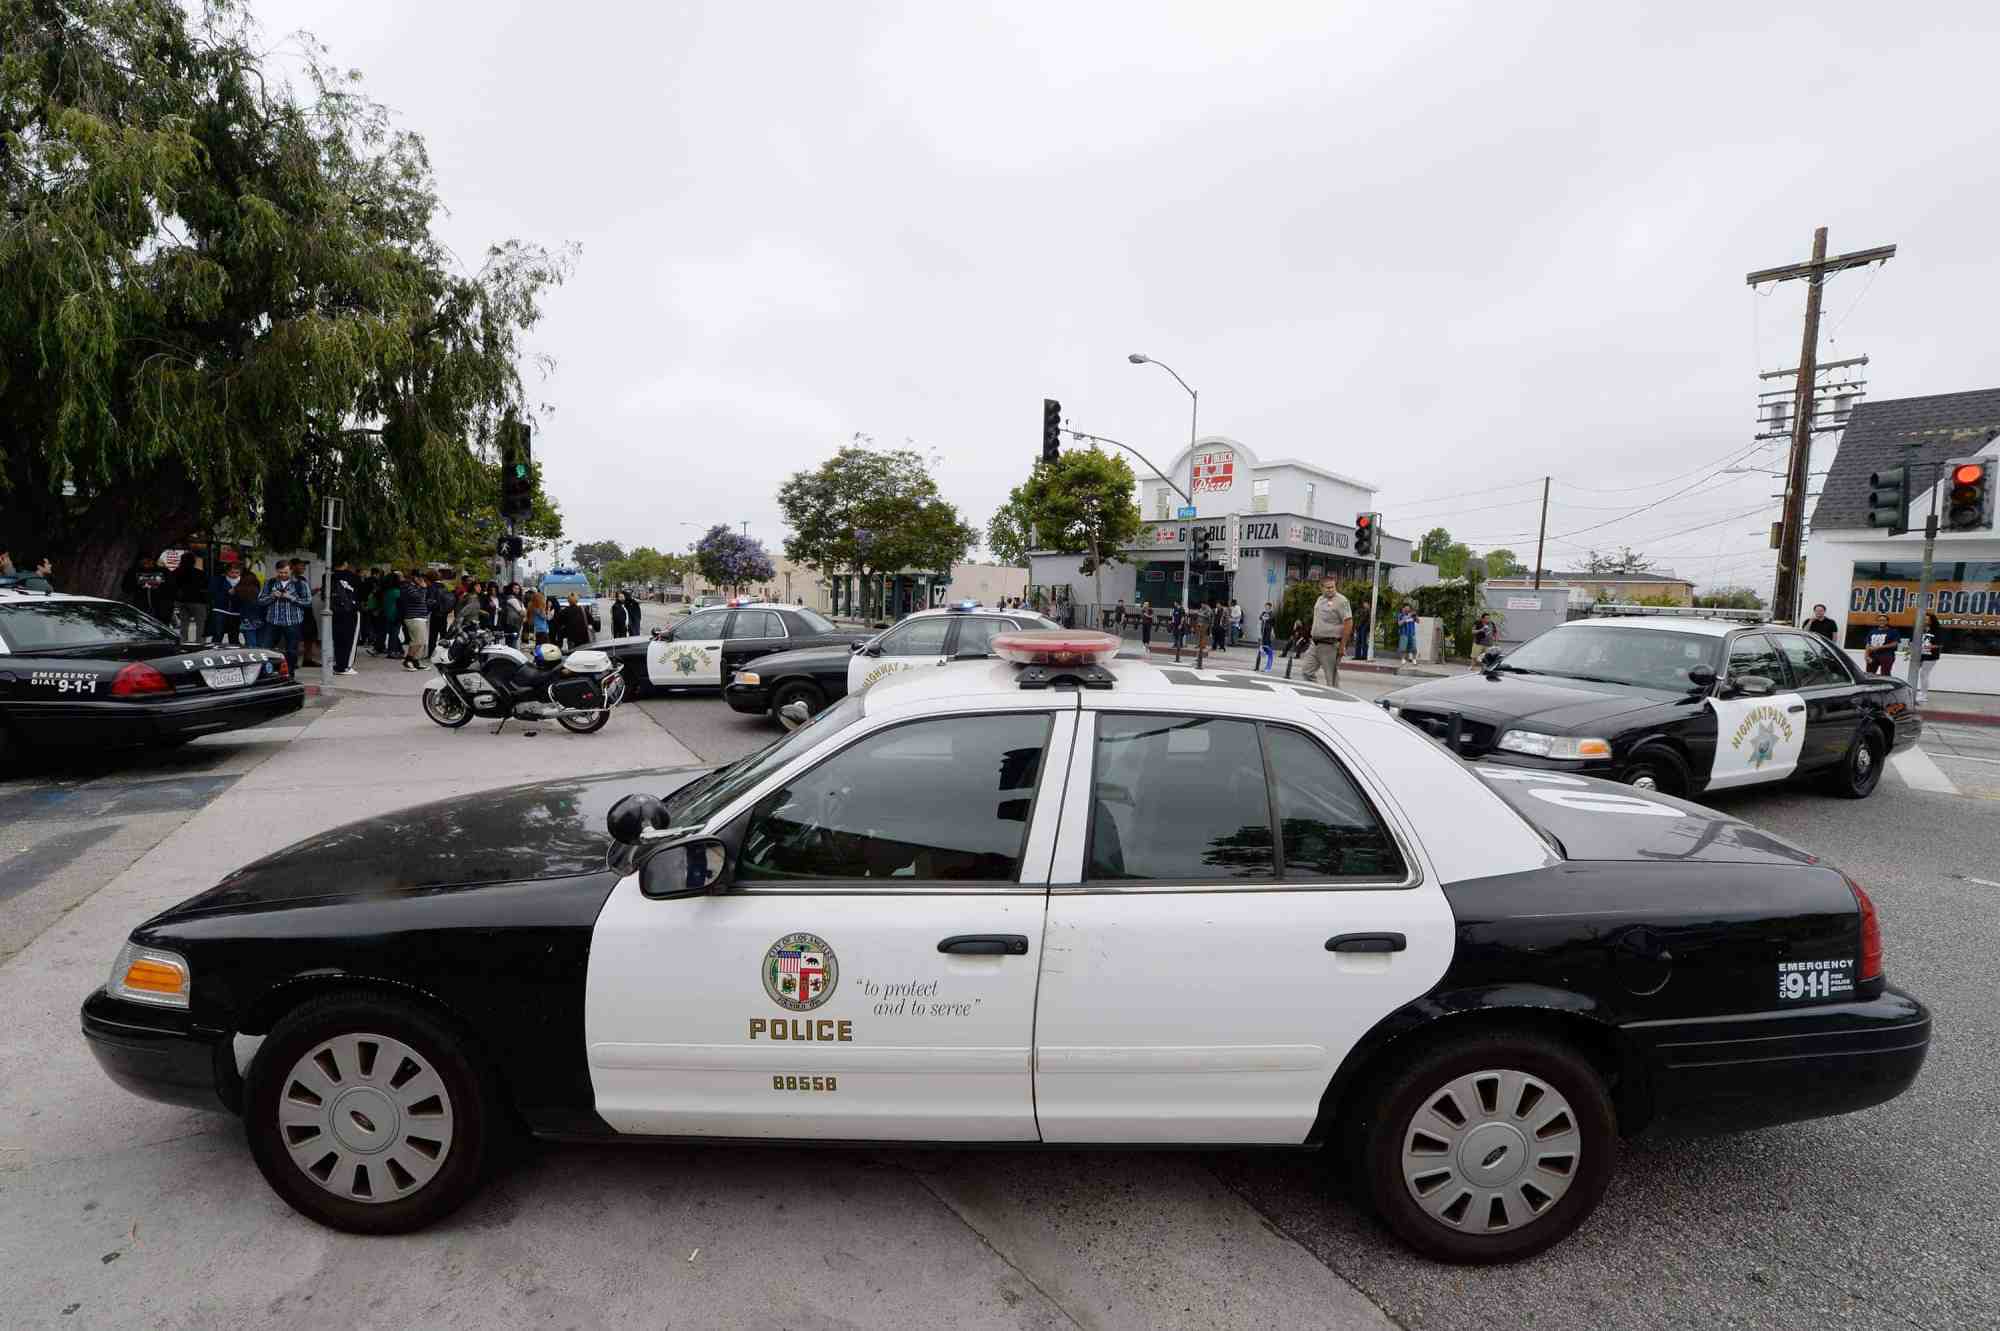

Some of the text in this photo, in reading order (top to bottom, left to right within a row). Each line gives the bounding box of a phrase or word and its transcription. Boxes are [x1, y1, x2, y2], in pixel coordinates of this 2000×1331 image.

[1247, 523, 1279, 540] PIZZA
[182, 652, 269, 671] POLICE
[32, 671, 99, 679] EMERGENCY
[58, 679, 96, 693] 9-1-1
[1778, 960, 1854, 972] EMERGENCY
[883, 978, 938, 1000] protect
[1779, 974, 1787, 998] CALL
[1786, 971, 1830, 999] 9-1-1
[873, 998, 905, 1016] and
[911, 999, 926, 1016] to
[749, 1018, 853, 1041] POLICE
